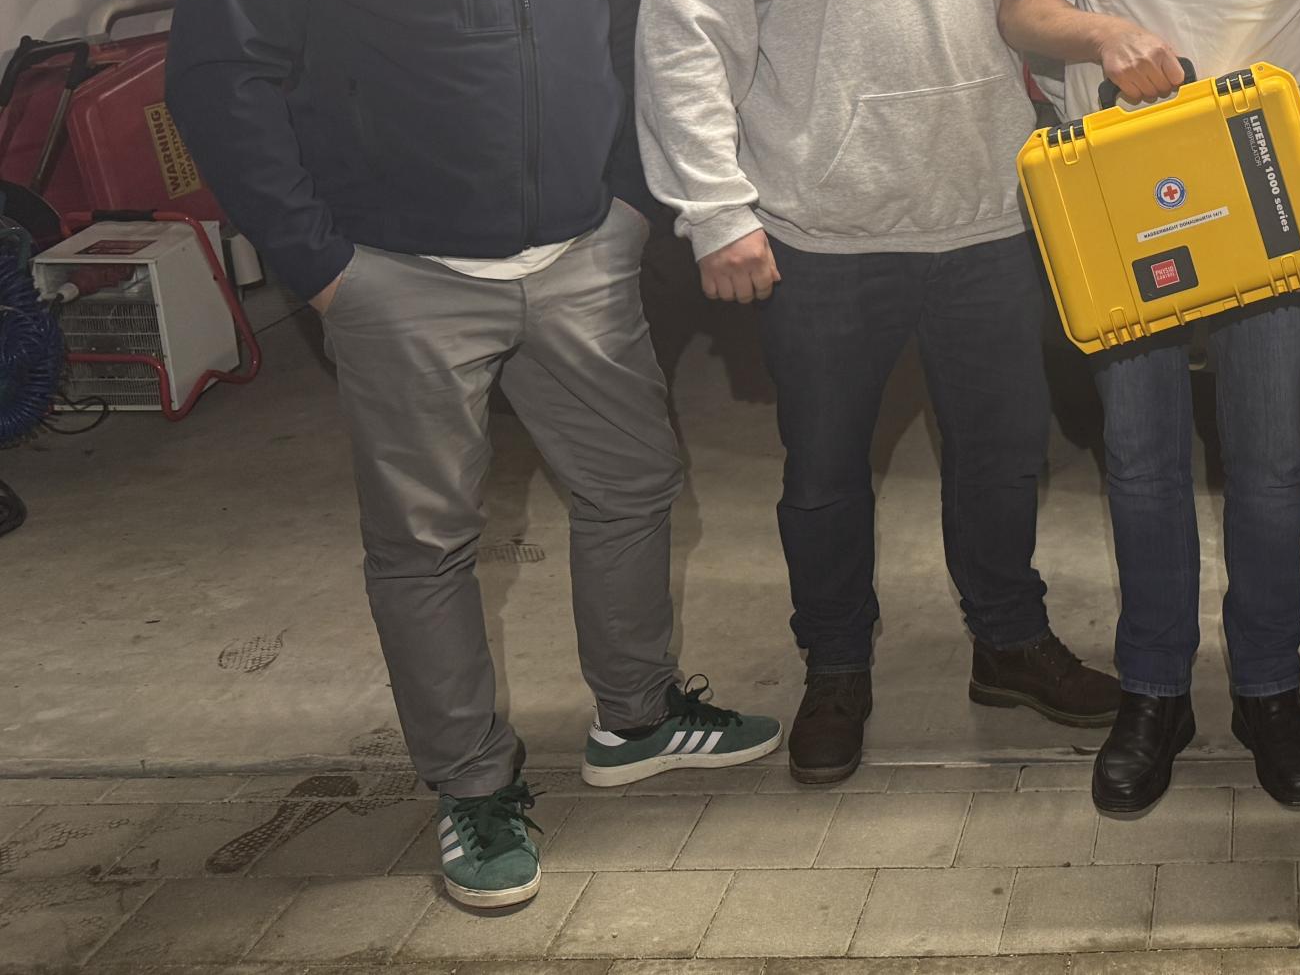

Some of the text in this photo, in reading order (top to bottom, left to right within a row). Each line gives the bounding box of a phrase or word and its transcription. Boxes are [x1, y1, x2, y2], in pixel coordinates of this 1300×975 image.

[151, 110, 181, 192] WARNING
[178, 162, 191, 187] STAY
[1249, 114, 1291, 233] LIFEPAK 1000 series
[1154, 264, 1175, 277] PHYSIO
